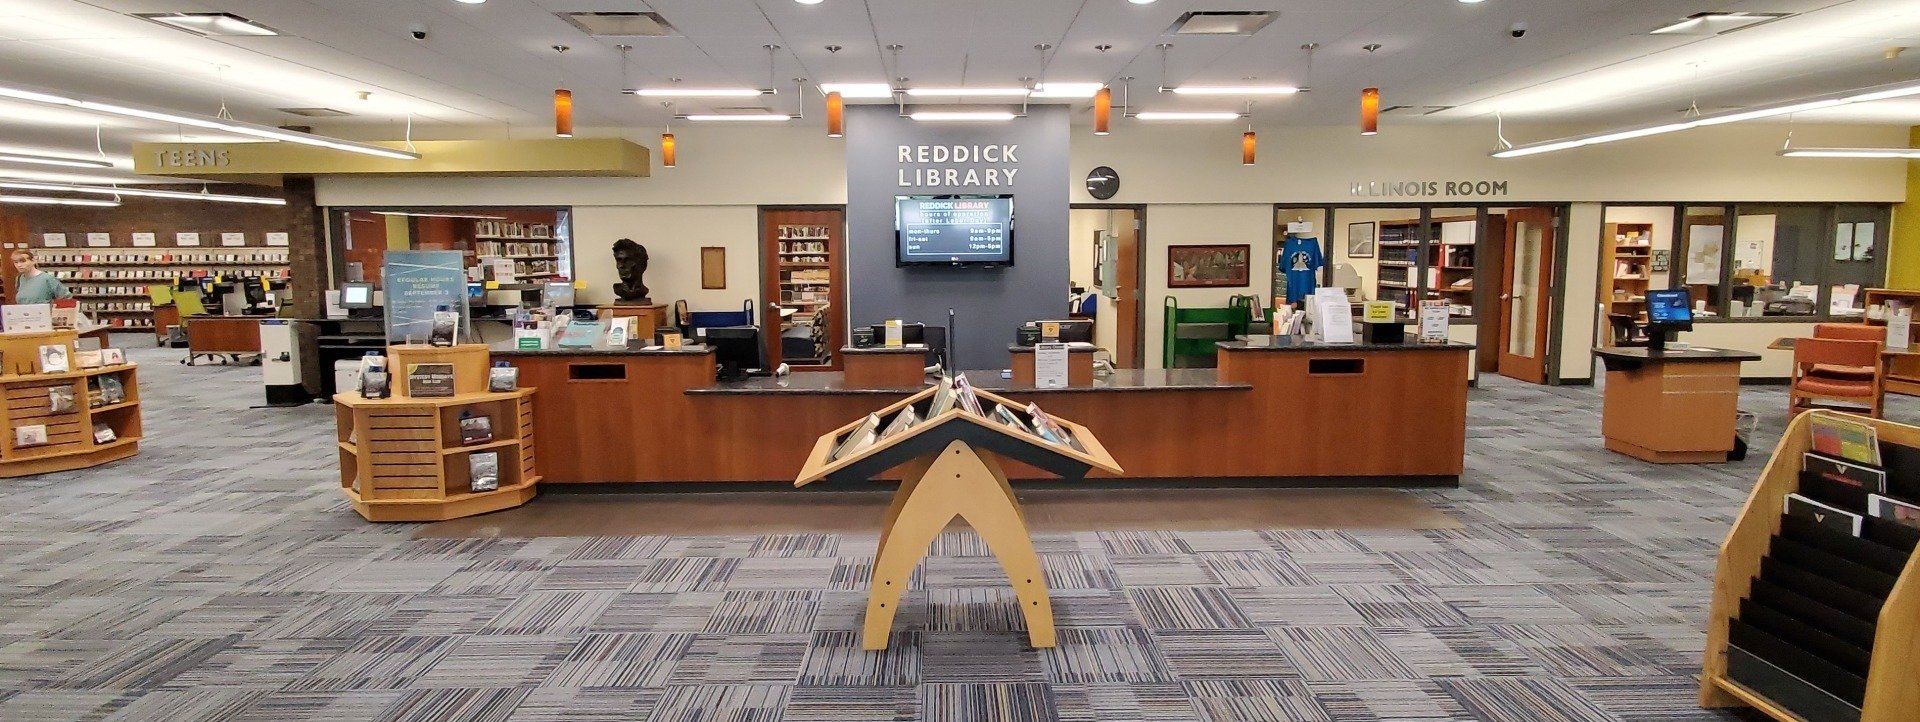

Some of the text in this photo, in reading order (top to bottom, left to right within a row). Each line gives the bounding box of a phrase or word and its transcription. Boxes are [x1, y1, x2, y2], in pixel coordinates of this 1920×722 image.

[155, 150, 231, 167] TEENS
[898, 145, 1019, 163] REDDICK
[898, 168, 1019, 187] LIBRARY
[1350, 180, 1508, 197] ILLINOIS ROOM
